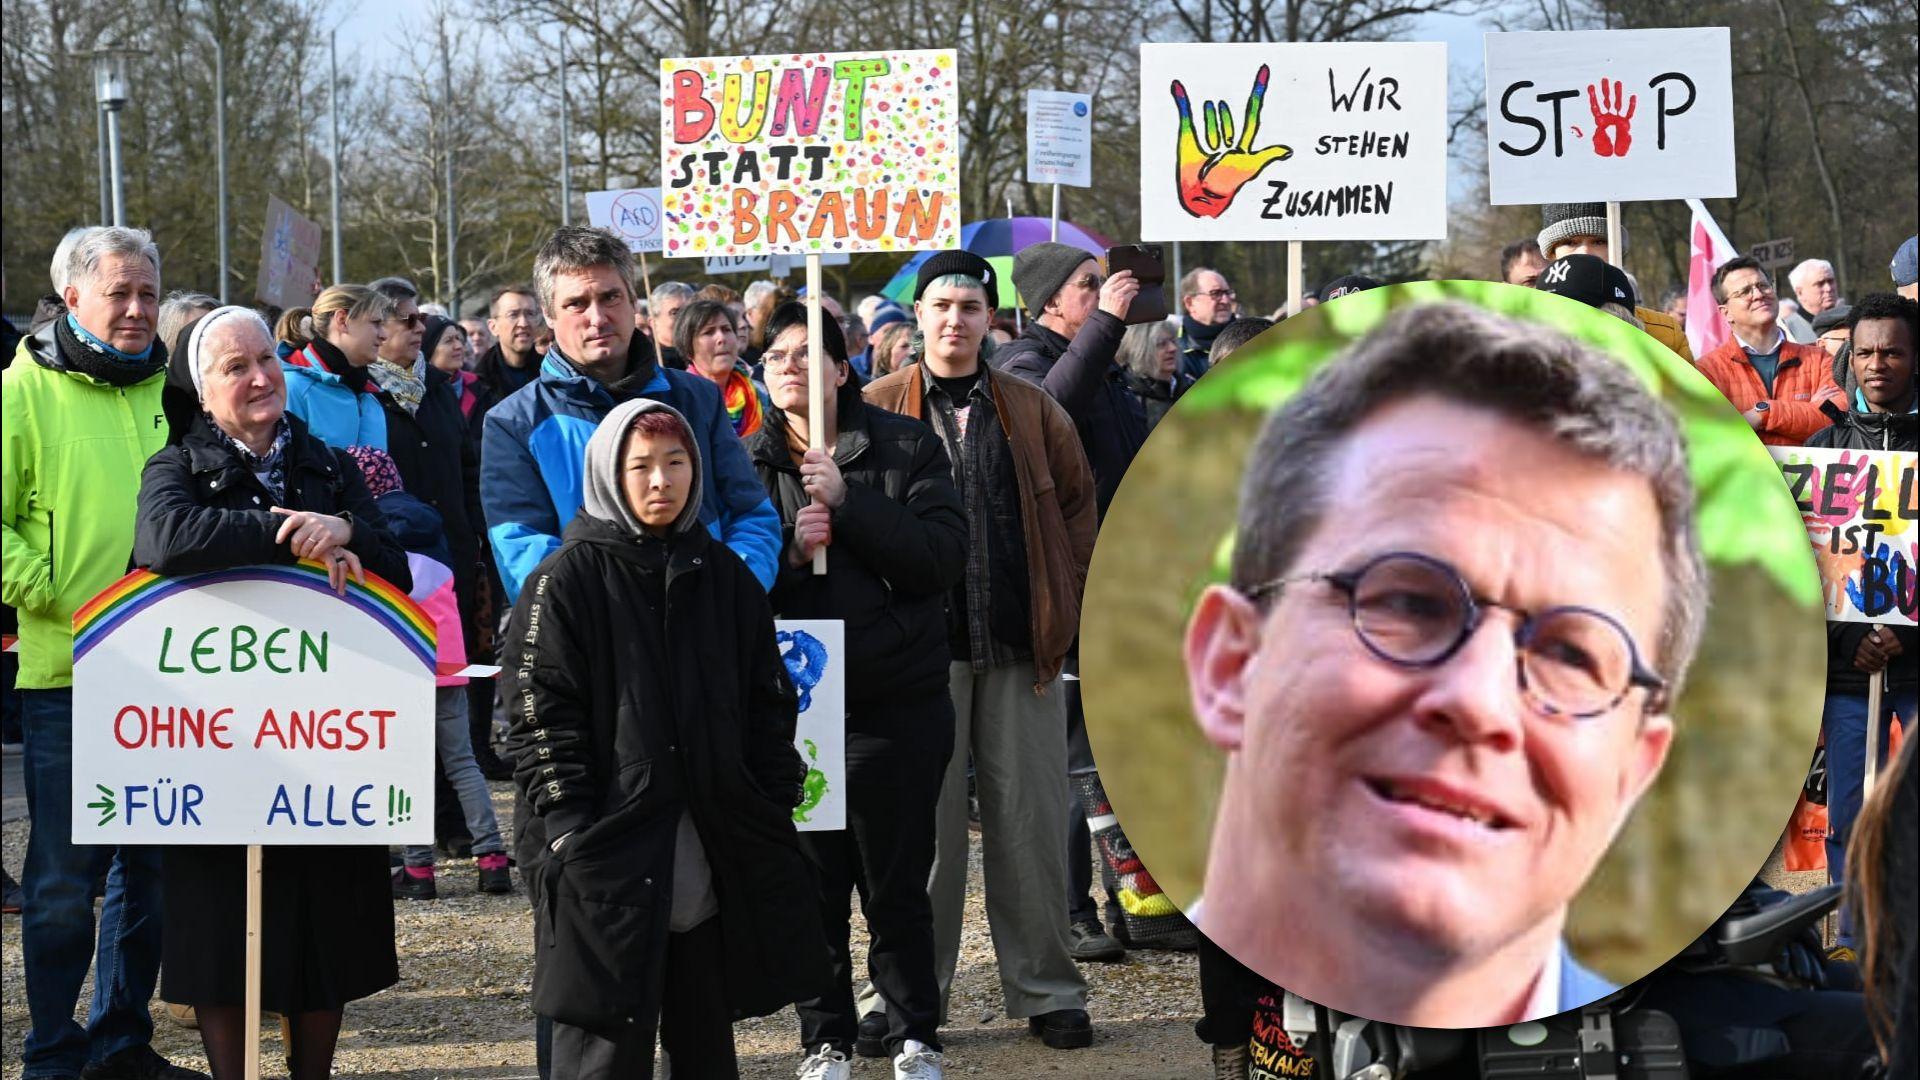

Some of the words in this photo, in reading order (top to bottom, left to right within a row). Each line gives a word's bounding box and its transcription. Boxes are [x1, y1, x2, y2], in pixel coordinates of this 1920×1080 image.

[673, 58, 891, 144] BUNT
[1328, 66, 1402, 113] WIR
[1498, 71, 1697, 158] STP
[670, 145, 831, 188] STATT
[1314, 130, 1410, 159] STEHEN
[732, 187, 944, 245] BRAUN
[1260, 180, 1393, 220] ZUSAMMEN
[1831, 523, 1884, 555] IST
[525, 603, 541, 646] STREET
[158, 624, 329, 674] LEBEN
[113, 705, 234, 750] OHNE
[253, 708, 397, 752] ANGST
[124, 777, 204, 827] FÜR
